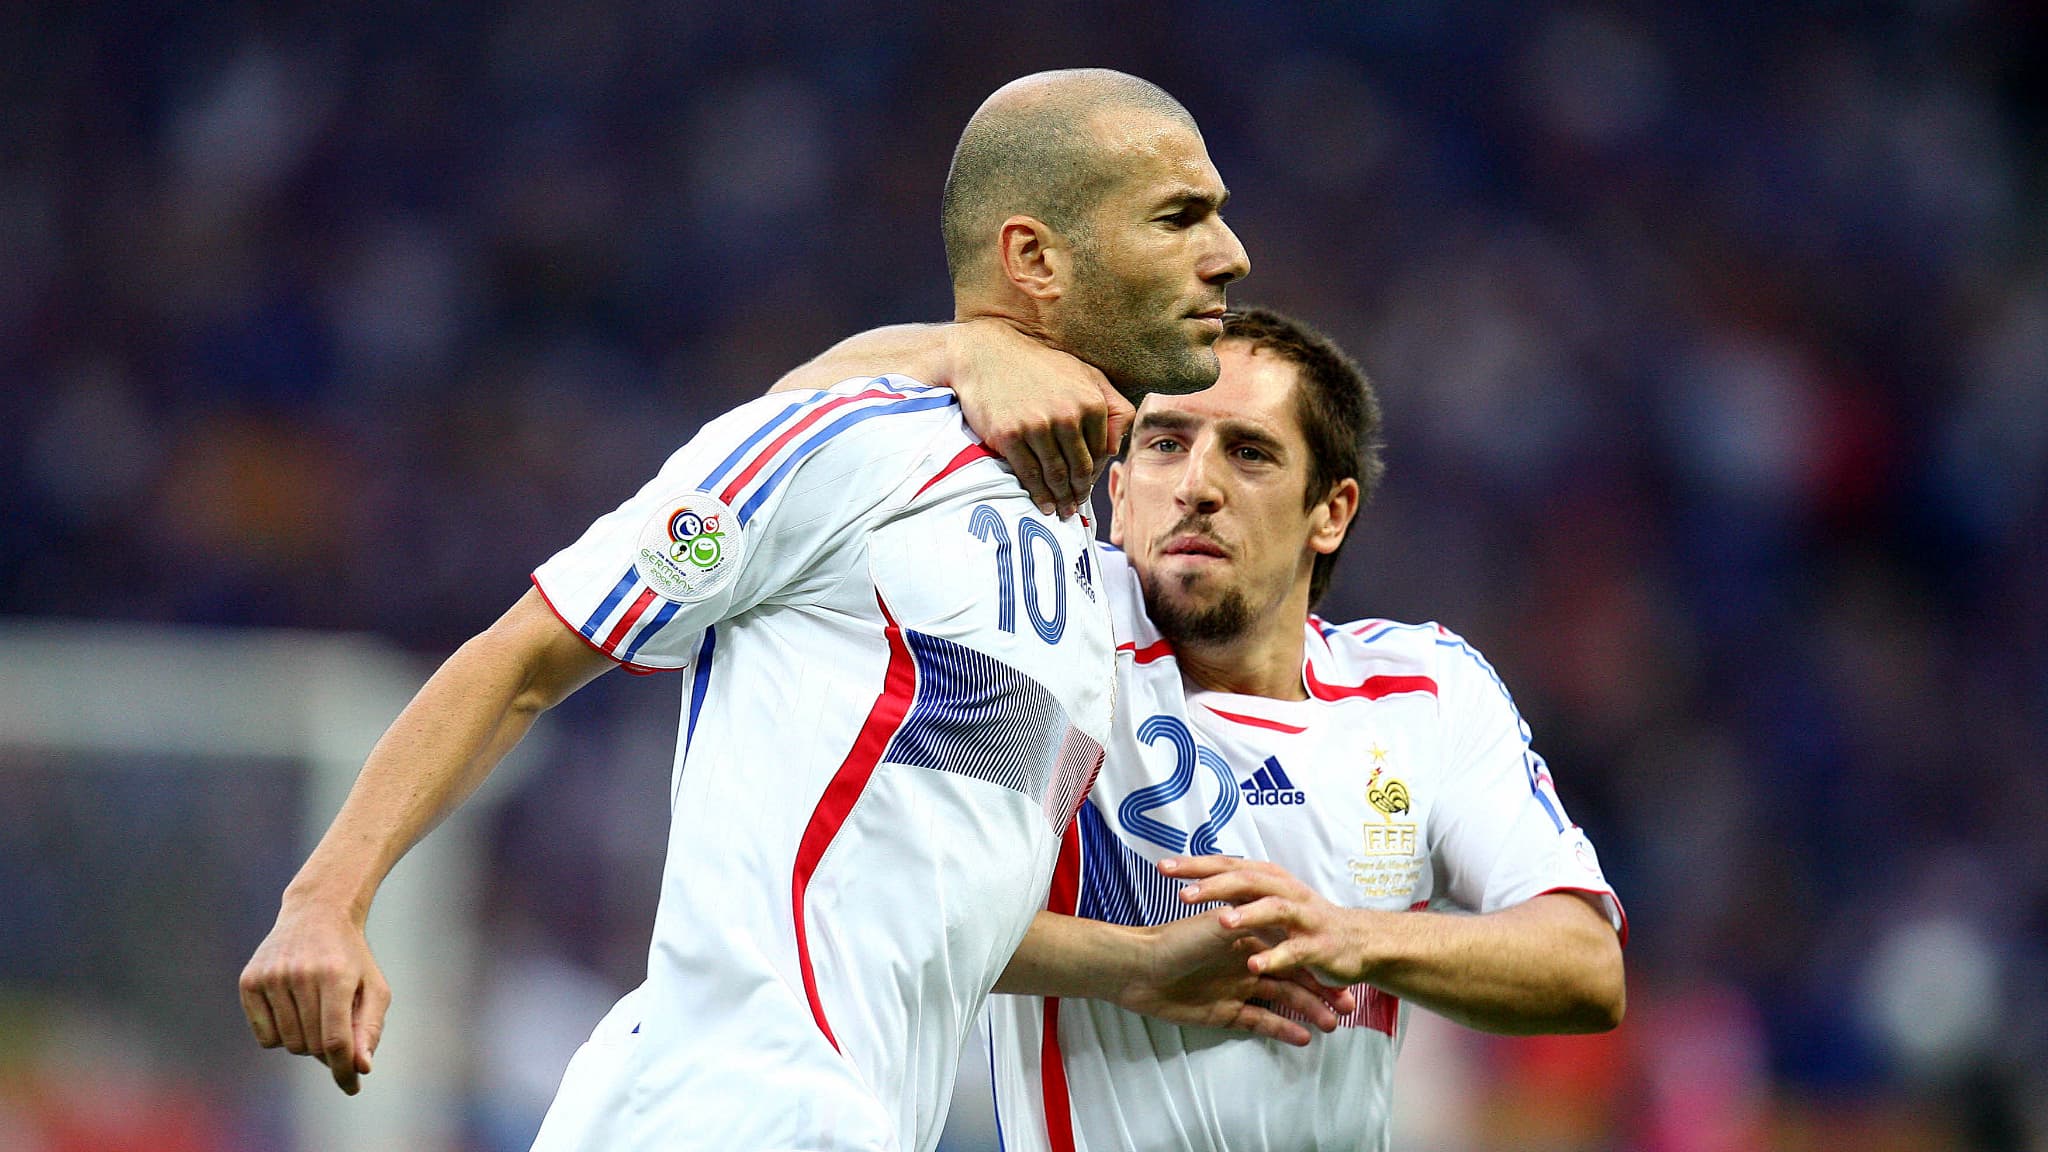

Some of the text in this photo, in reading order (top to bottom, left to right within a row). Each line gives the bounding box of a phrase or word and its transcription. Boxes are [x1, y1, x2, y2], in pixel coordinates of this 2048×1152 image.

[641, 549, 693, 592] GERMANY
[651, 568, 671, 586] 2006
[968, 504, 1067, 645] 10
[1118, 715, 1243, 858] 22
[1243, 789, 1305, 805] didas
